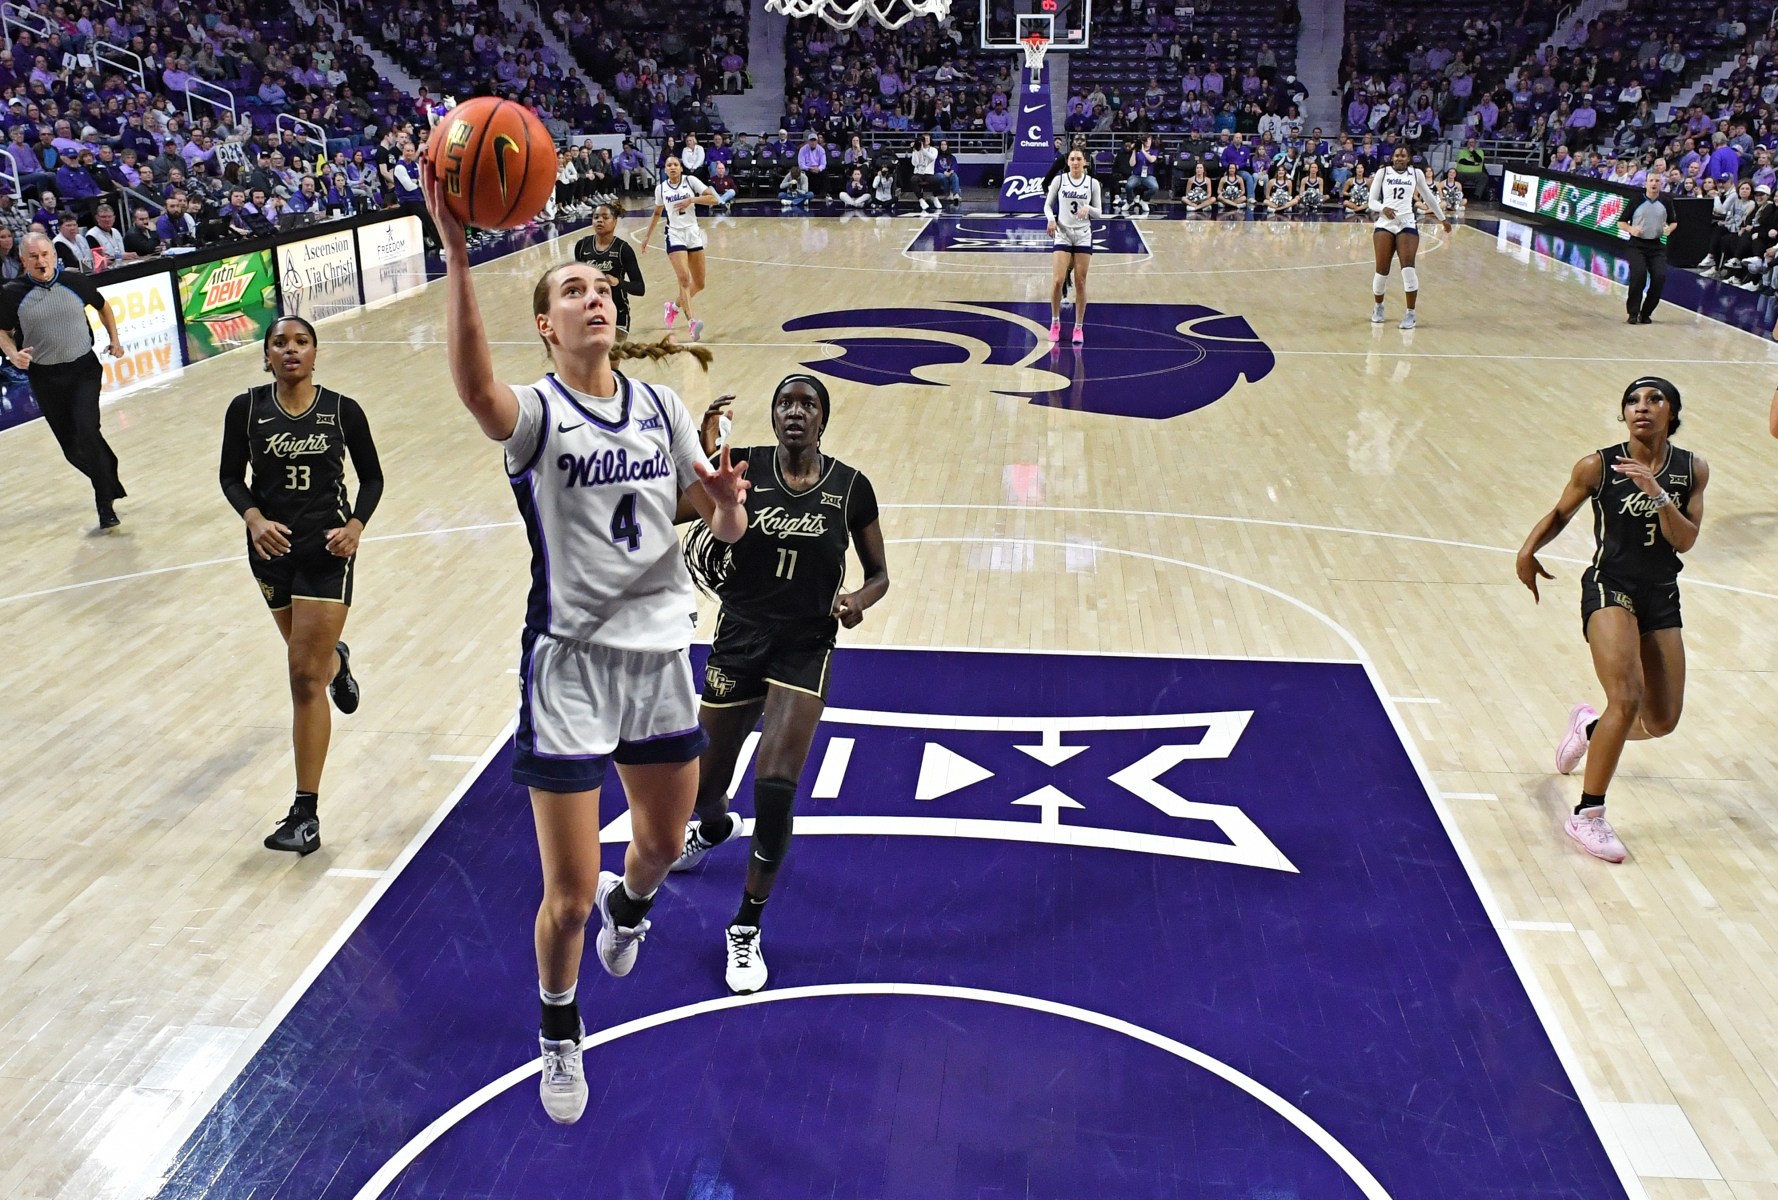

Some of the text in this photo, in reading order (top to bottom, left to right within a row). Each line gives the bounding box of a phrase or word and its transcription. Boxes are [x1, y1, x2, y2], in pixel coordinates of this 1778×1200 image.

[1061, 190, 1088, 200] Wildcats
[1393, 187, 1405, 200] 12
[1070, 200, 1078, 215] 3
[304, 237, 349, 261] Ascension
[305, 266, 322, 285] Via
[323, 257, 354, 281] Christi
[263, 432, 331, 459] Knights
[285, 466, 311, 491] 33
[557, 448, 671, 489] Wildcats
[1618, 491, 1683, 517] Knigts
[609, 492, 643, 553] 4
[749, 506, 829, 540] Knights
[1643, 523, 1657, 547] 3
[775, 547, 798, 581] 11
[706, 665, 737, 698] UCF
